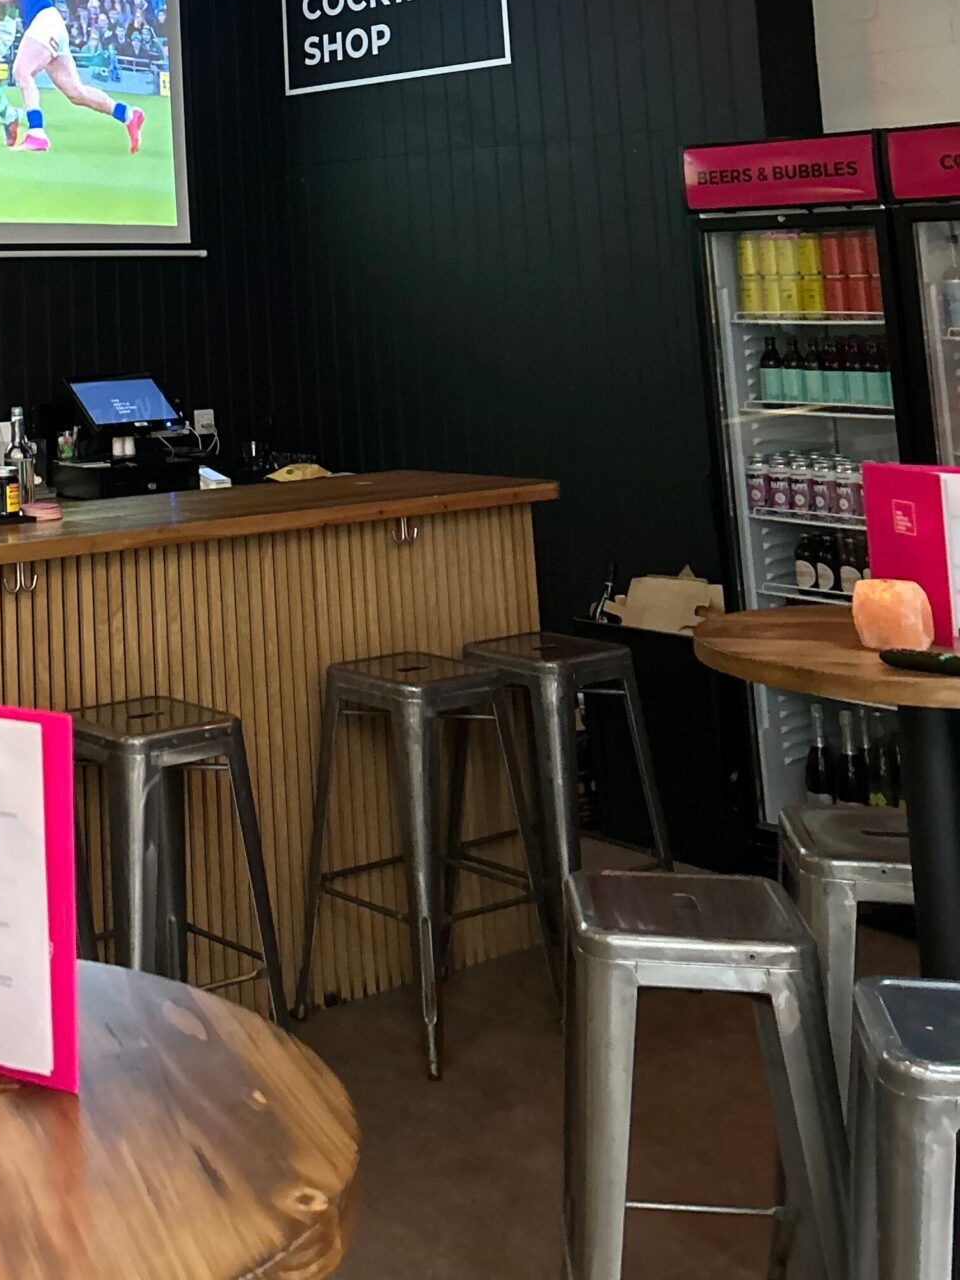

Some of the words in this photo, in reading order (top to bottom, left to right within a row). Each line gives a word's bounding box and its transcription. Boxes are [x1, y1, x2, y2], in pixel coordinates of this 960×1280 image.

[303, 23, 391, 66] SHOP
[697, 168, 752, 186] BEERS
[757, 167, 769, 183] &
[772, 160, 859, 182] BUBBLES
